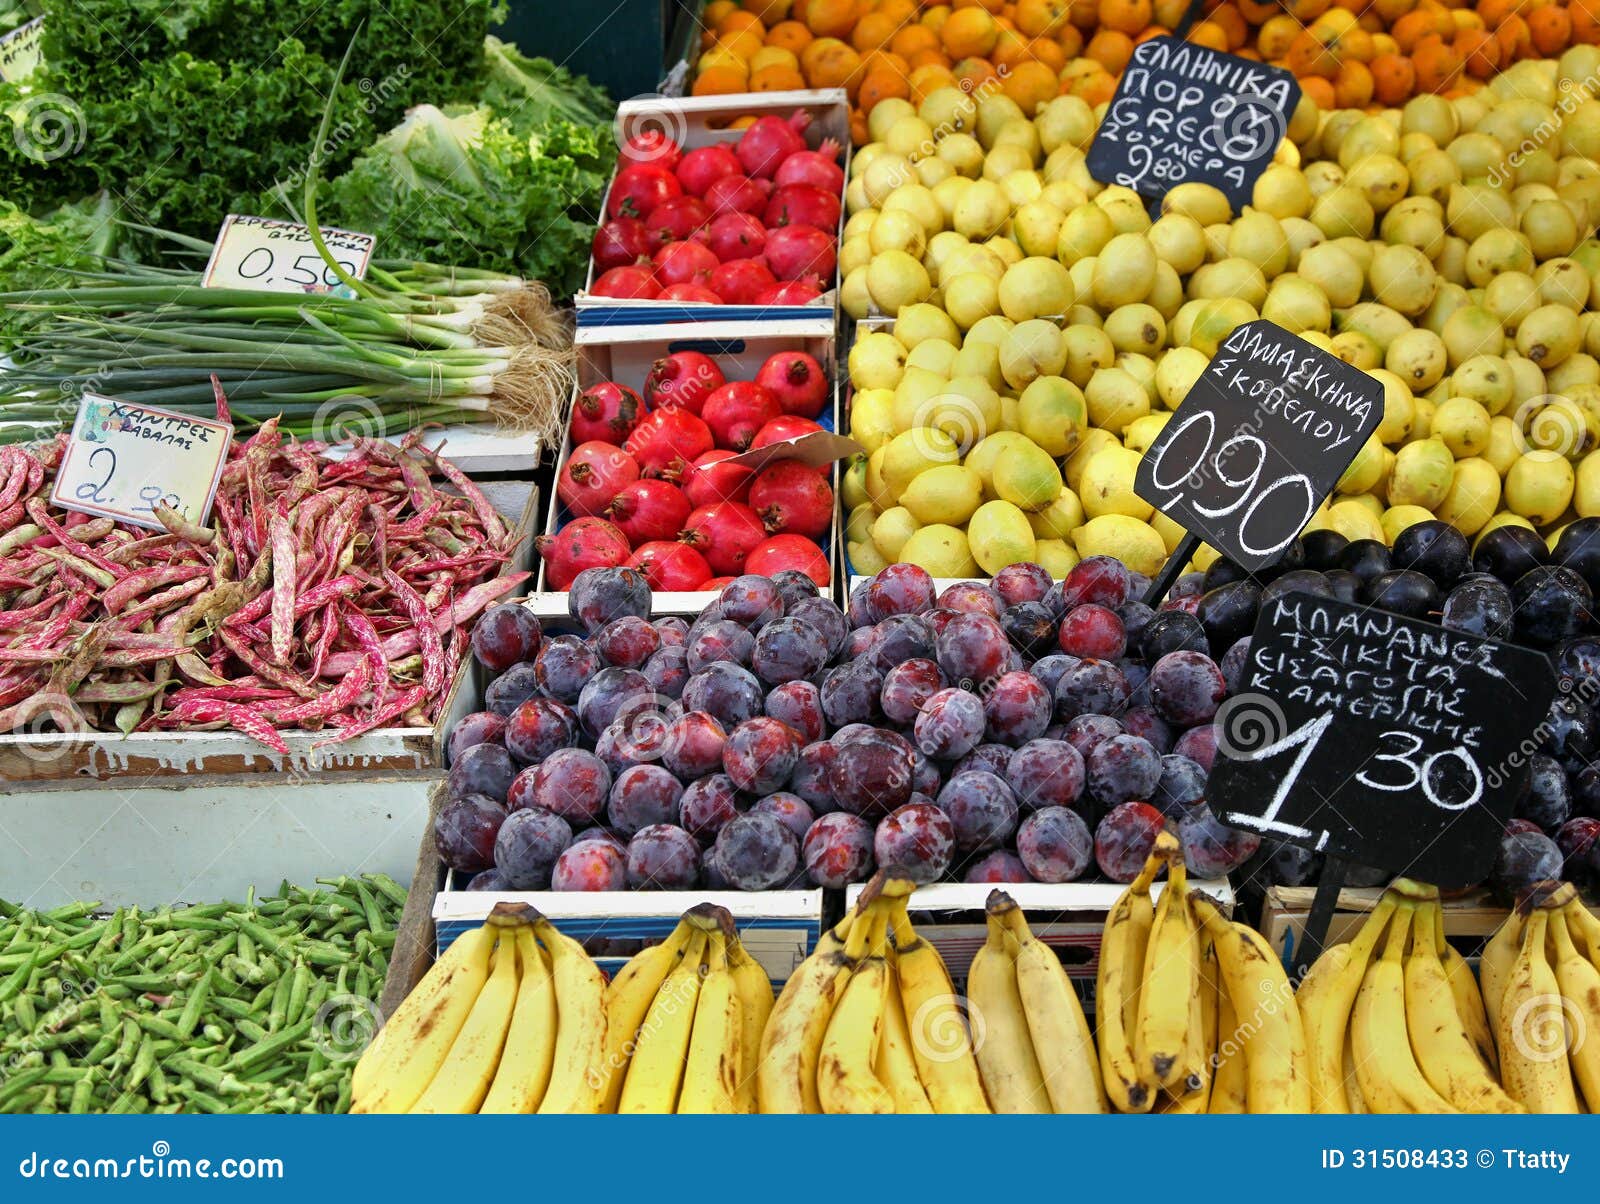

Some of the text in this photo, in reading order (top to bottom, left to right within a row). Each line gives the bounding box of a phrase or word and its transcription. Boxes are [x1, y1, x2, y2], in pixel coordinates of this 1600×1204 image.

[1134, 41, 1291, 112] ΕΛΛΗΝΙΚΑ
[1112, 98, 1257, 160] GRECO
[239, 247, 356, 286] 0,50
[1213, 358, 1351, 452] ΣΚΟΠΕΛΟΥ
[1224, 325, 1372, 432] ΔΑΜΑΣΚΗΝΑ
[108, 402, 216, 443] ΧΑΝΤΡΕΣ
[119, 423, 193, 450] ΚΑΒΑΛΑΣ
[1153, 410, 1314, 555] 0,90
[1273, 600, 1504, 678] ΜΠΑΝΑΝΕΣ
